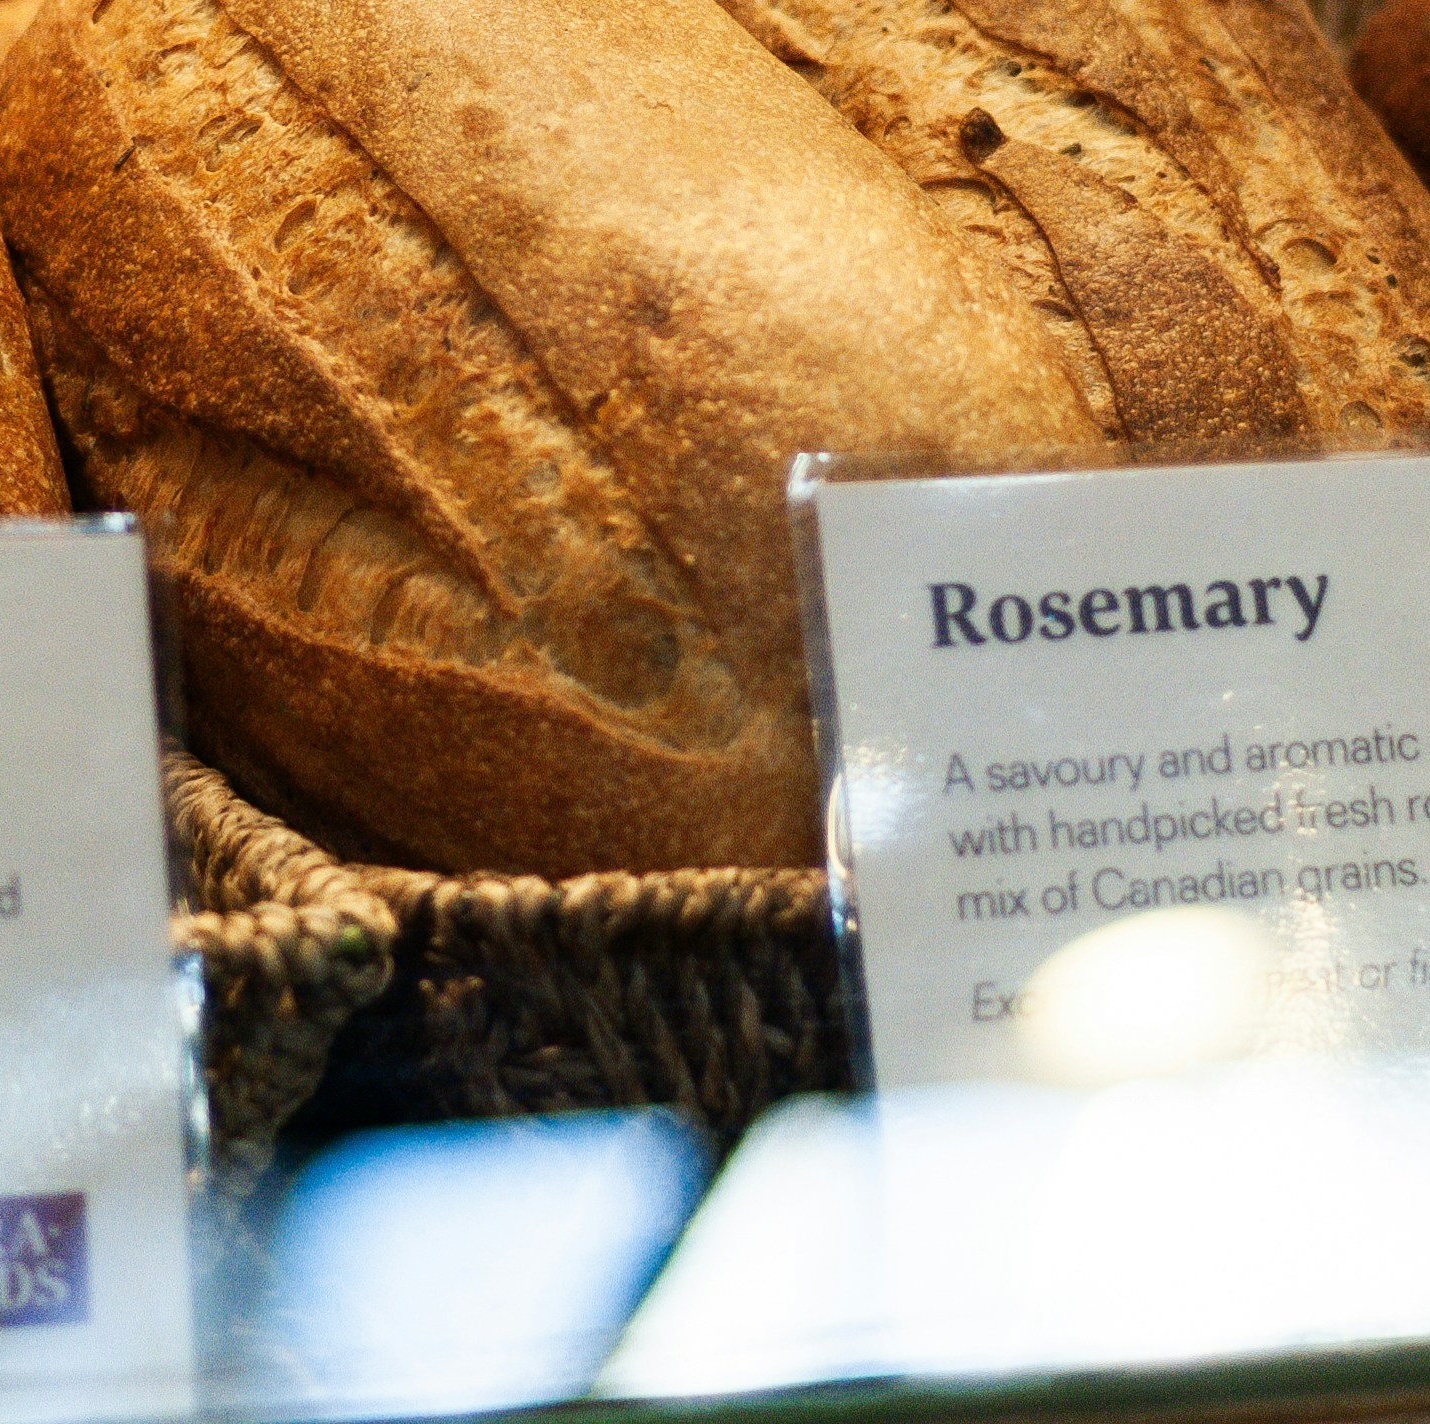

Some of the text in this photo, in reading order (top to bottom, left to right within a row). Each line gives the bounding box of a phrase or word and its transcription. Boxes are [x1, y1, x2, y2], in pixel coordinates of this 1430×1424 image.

[927, 570, 1332, 651] Rosemary
[944, 751, 971, 795] A
[986, 743, 1144, 799] savoury
[1158, 734, 1231, 778] and
[1244, 721, 1421, 771] aromatic
[950, 813, 1037, 858] with
[1049, 795, 1284, 856] handpicked
[1295, 785, 1396, 830] fresh
[957, 849, 1428, 921] mix of Canadian grains.
